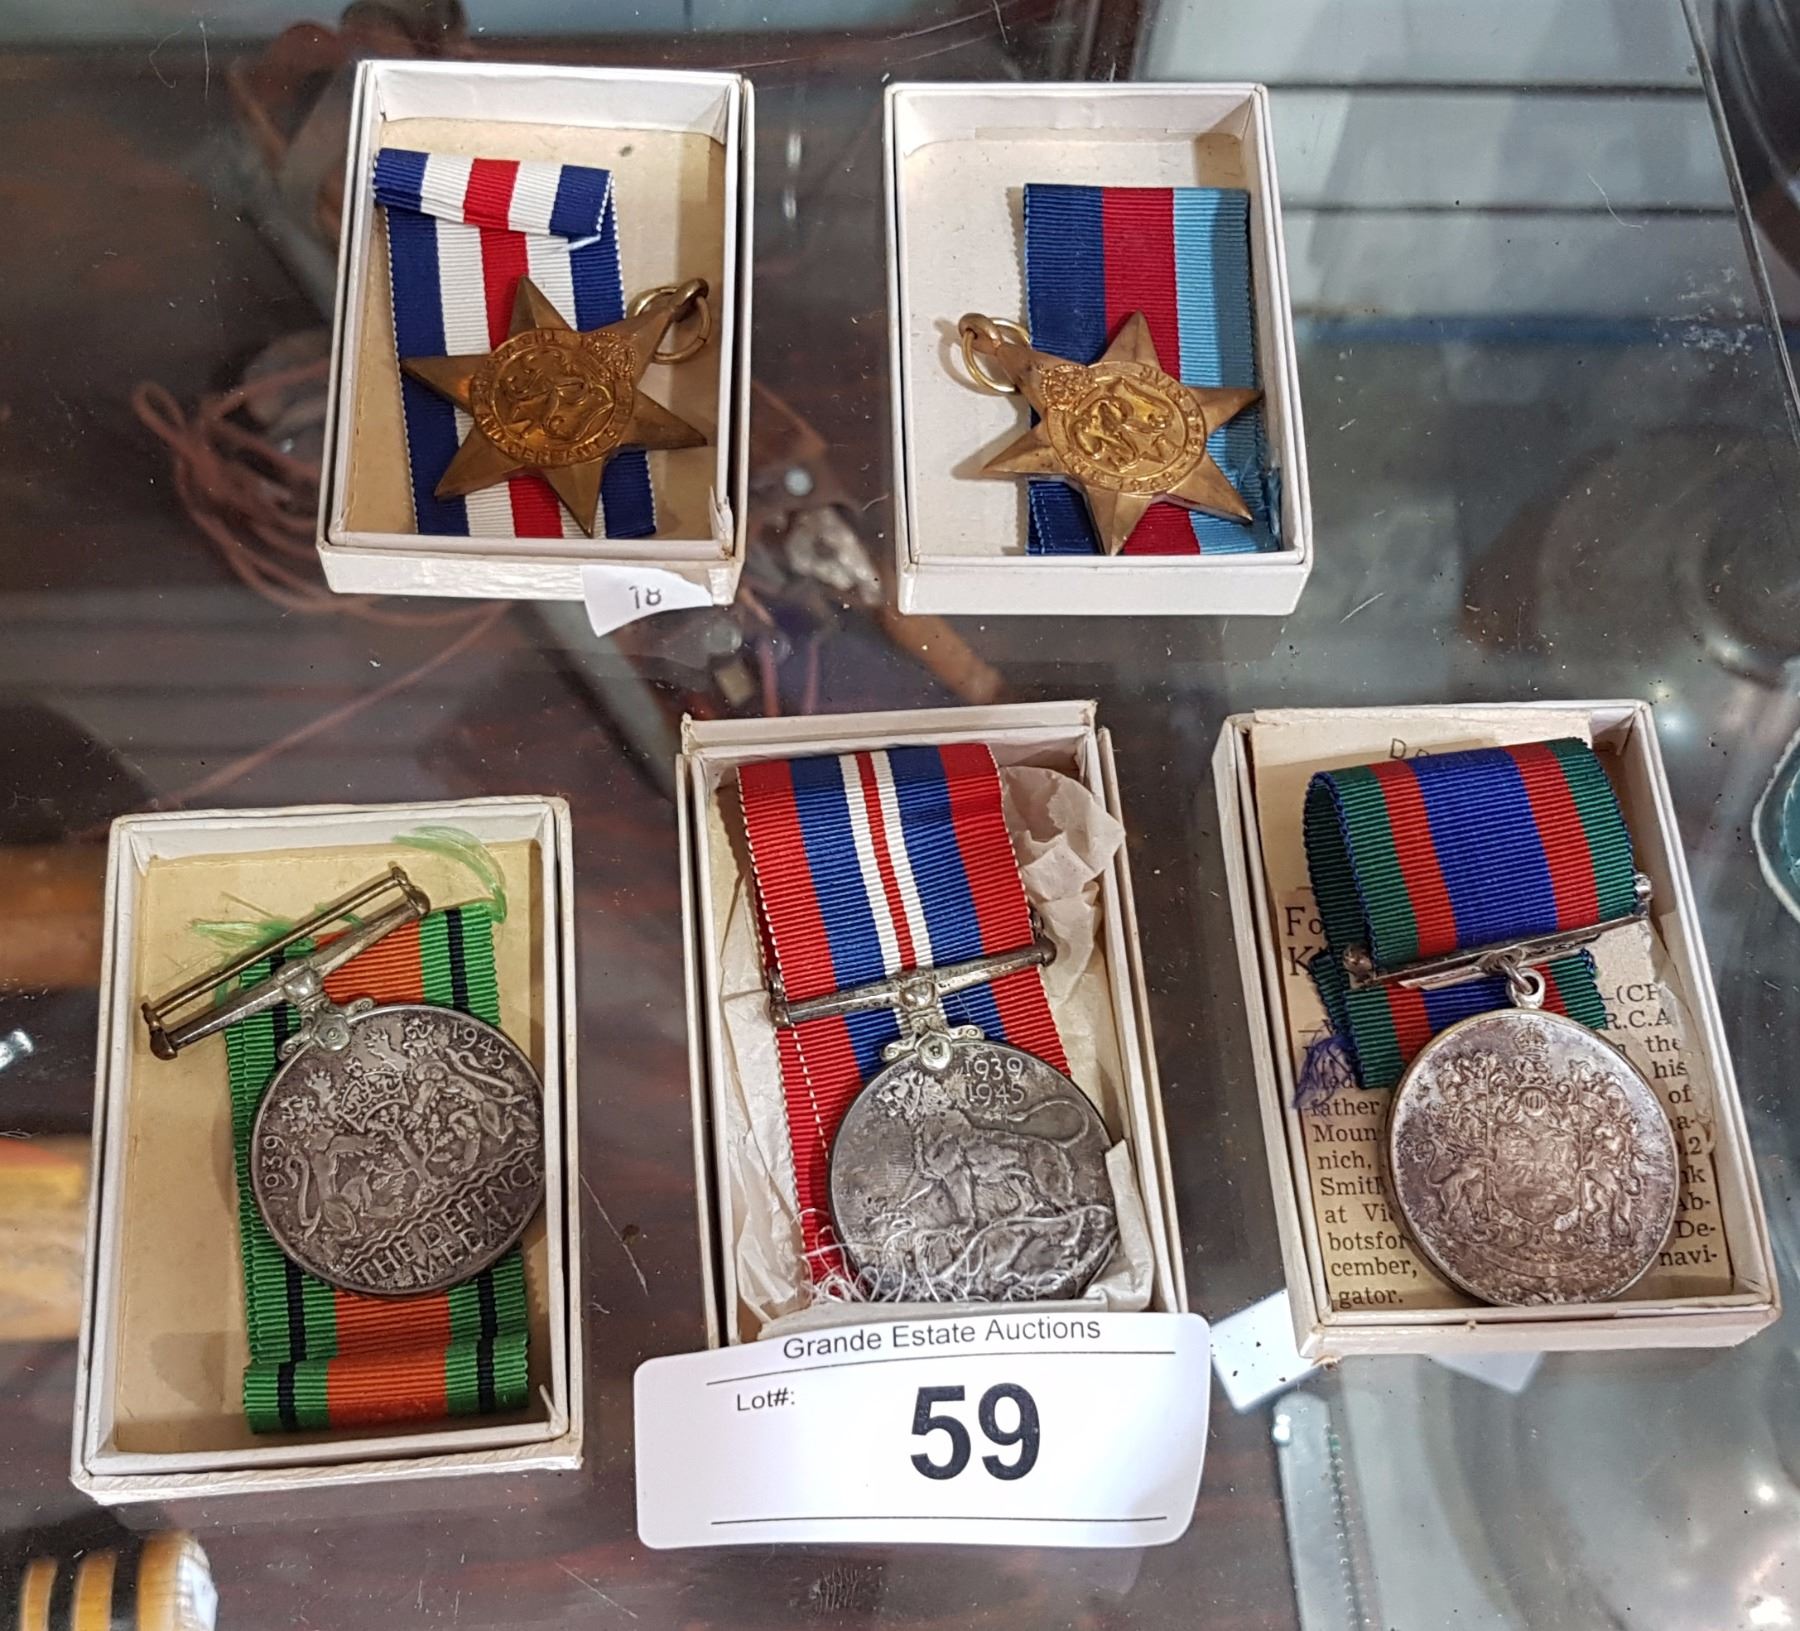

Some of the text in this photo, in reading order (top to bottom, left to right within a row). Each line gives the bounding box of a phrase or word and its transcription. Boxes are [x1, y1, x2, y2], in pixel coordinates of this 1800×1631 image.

[451, 1022, 511, 1069] 1945
[965, 1057, 1024, 1082] 1939
[1652, 1059, 1688, 1079] his
[966, 1083, 1026, 1105] 1945
[1668, 1084, 1693, 1104] of
[262, 1134, 287, 1202] 1939
[354, 1156, 543, 1286] THE DEFENCE
[1325, 1205, 1348, 1224] at
[1675, 1220, 1716, 1238] De-
[412, 1205, 527, 1285] MEDAL
[1331, 1244, 1718, 1279] cember, navi-
[1338, 1287, 1404, 1310] gator.
[783, 1316, 1101, 1360] Grande Estate Auctions
[736, 1382, 1041, 1481] Lot#: 59
